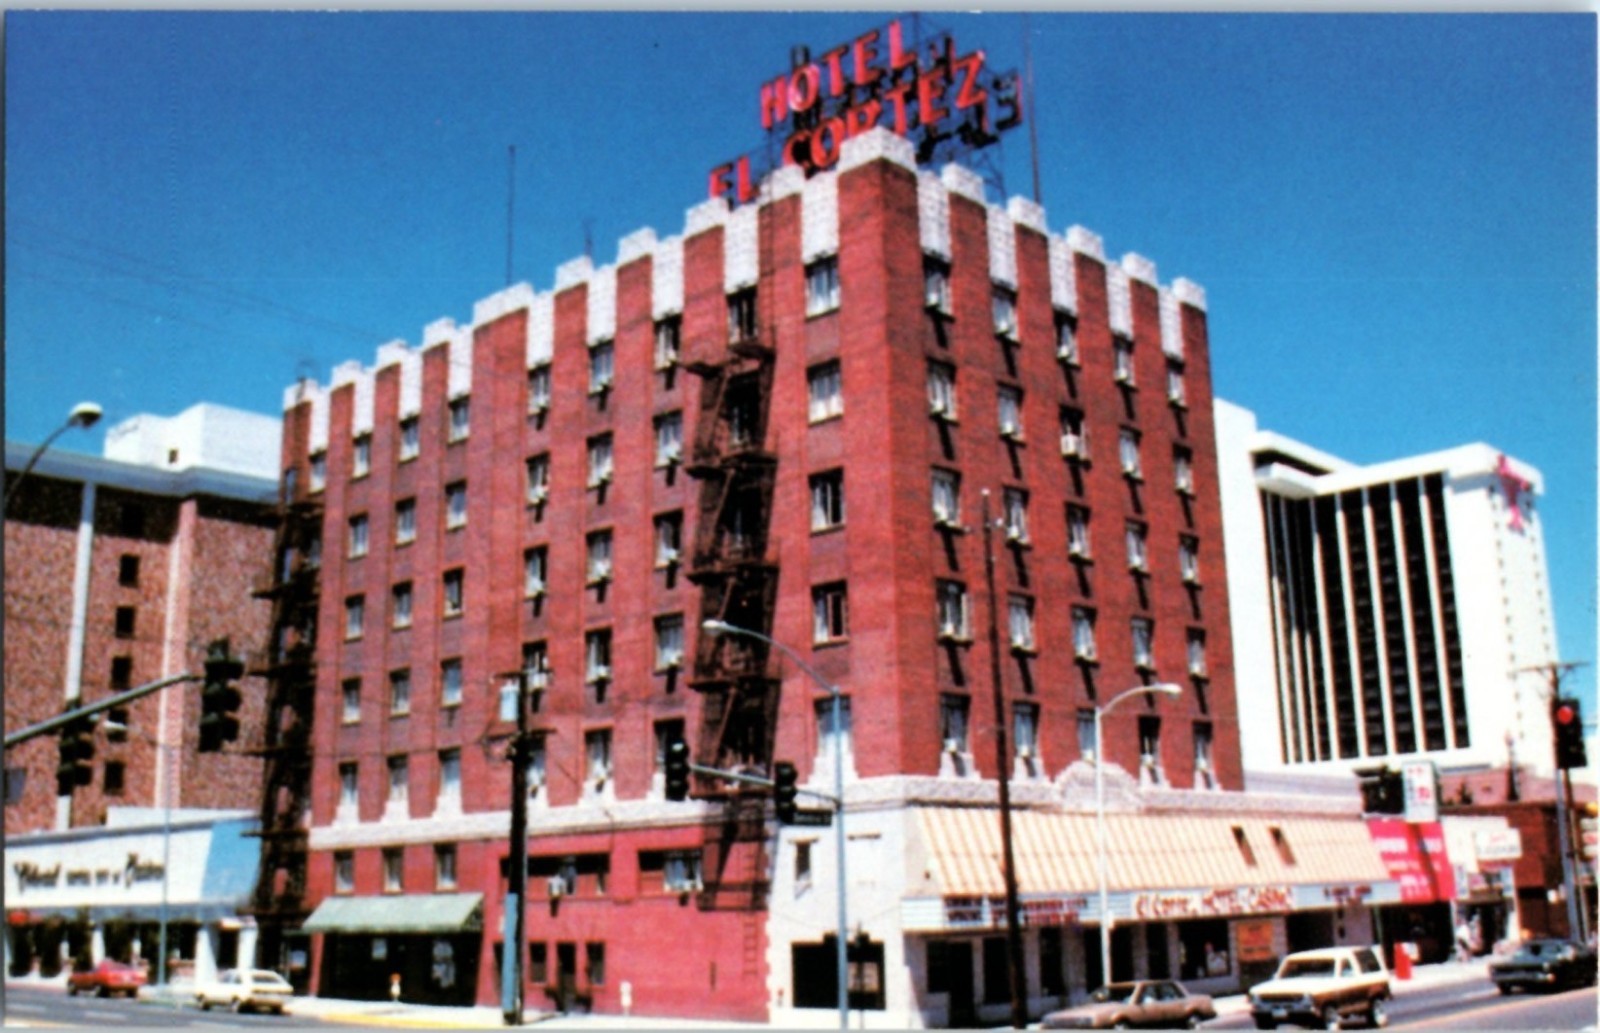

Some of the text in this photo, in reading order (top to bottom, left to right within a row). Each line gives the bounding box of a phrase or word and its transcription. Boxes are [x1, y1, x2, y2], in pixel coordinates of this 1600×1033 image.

[709, 50, 988, 204] EL CORTEZ
[760, 20, 917, 129] HOTEL
